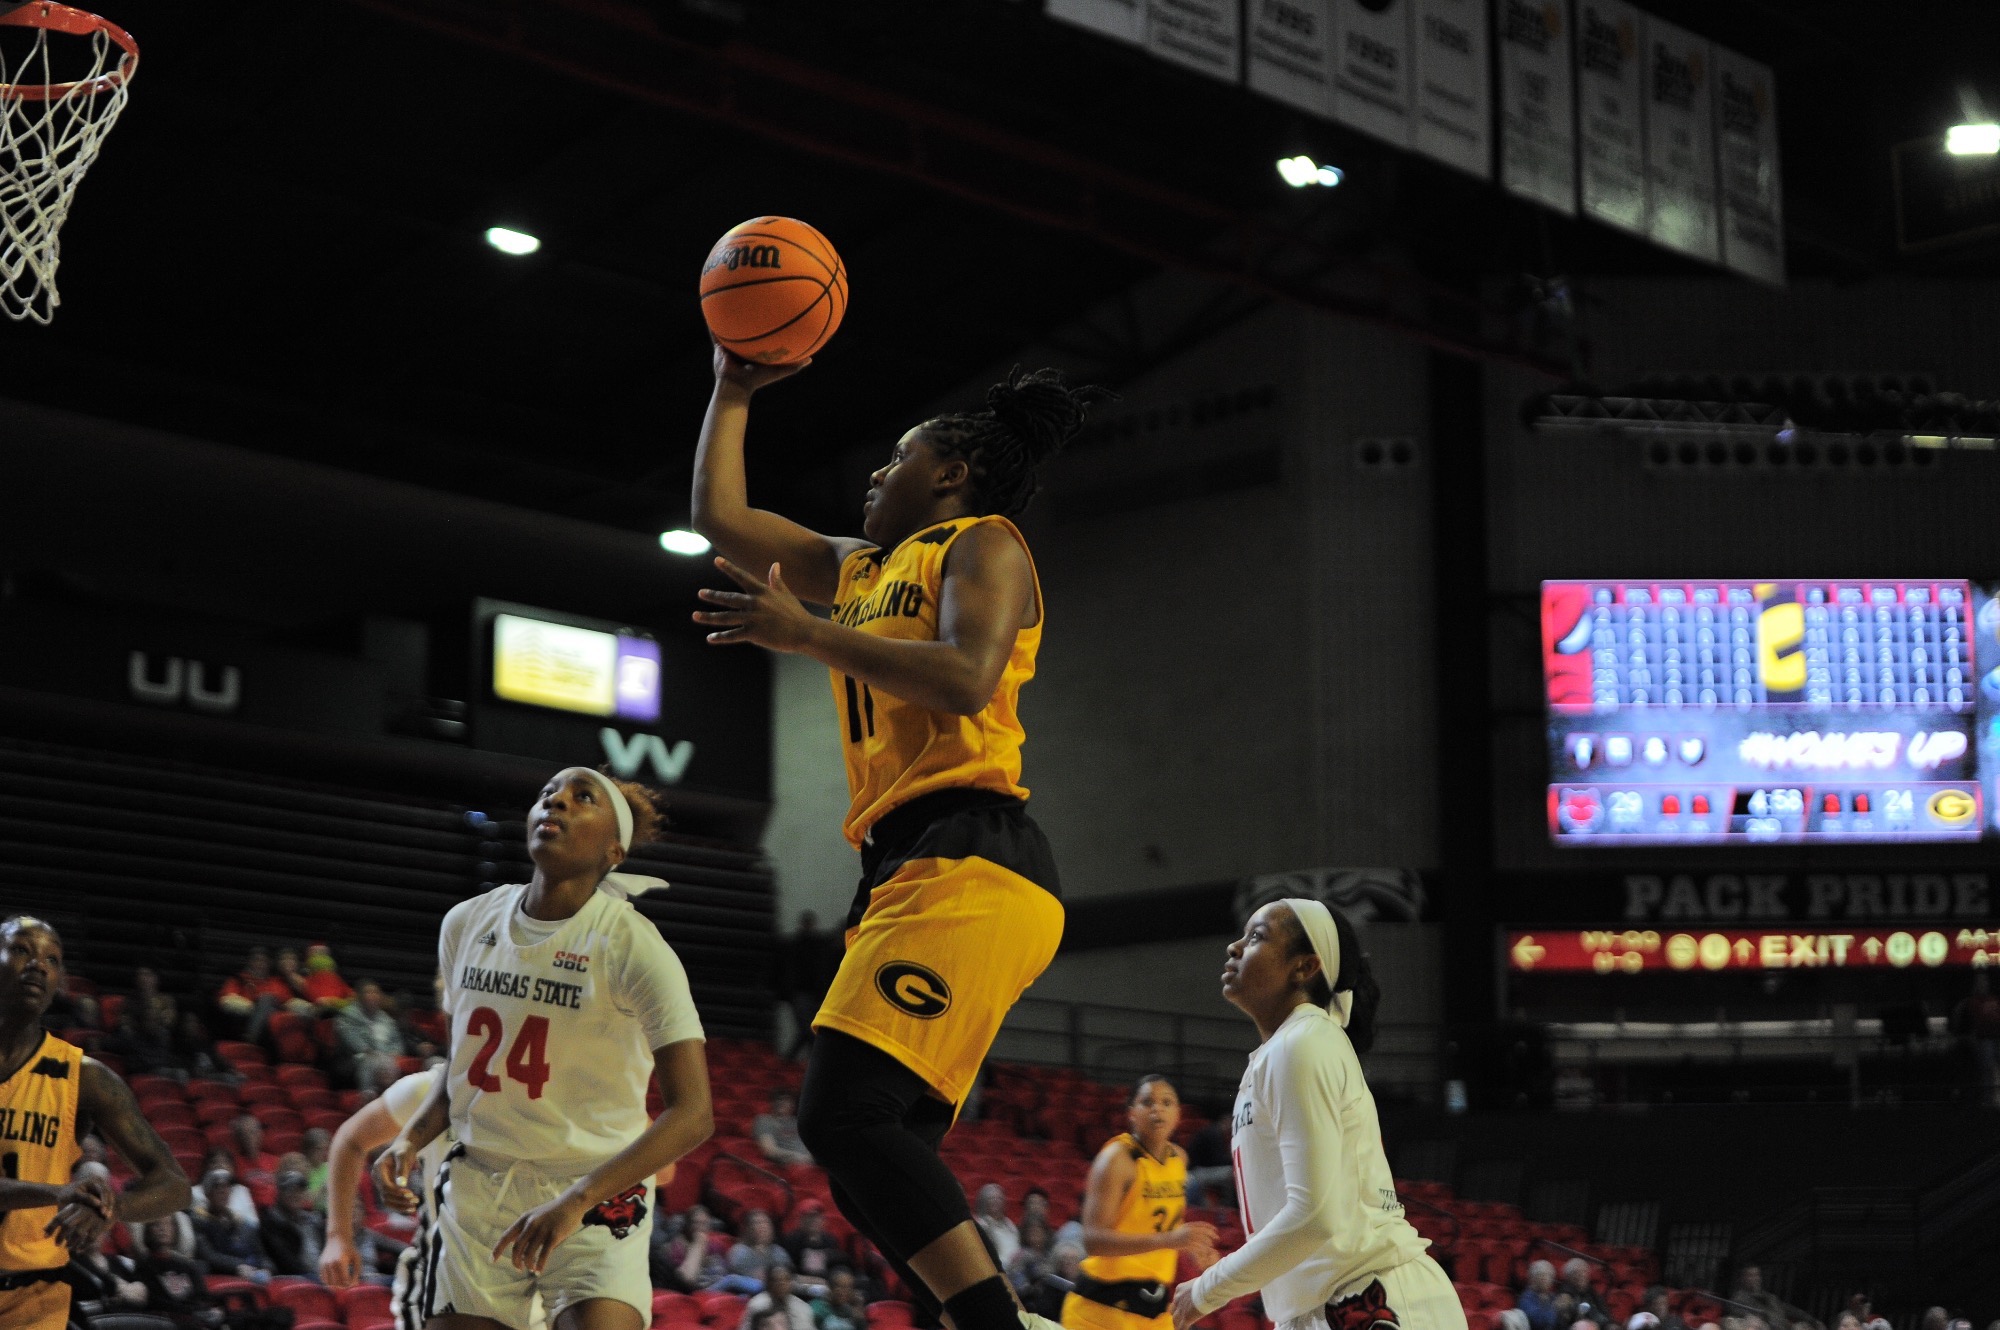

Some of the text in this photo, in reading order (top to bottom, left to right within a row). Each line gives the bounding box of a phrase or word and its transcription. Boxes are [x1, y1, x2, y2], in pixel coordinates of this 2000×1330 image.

[1907, 731, 1967, 768] UP
[1624, 873, 1991, 917] PACK PRIDE
[553, 950, 590, 972] SBC
[1760, 933, 1855, 968] EXIT
[461, 966, 583, 1008] ARKANSAS STATE
[875, 961, 951, 1018] G
[467, 1006, 550, 1100] 24
